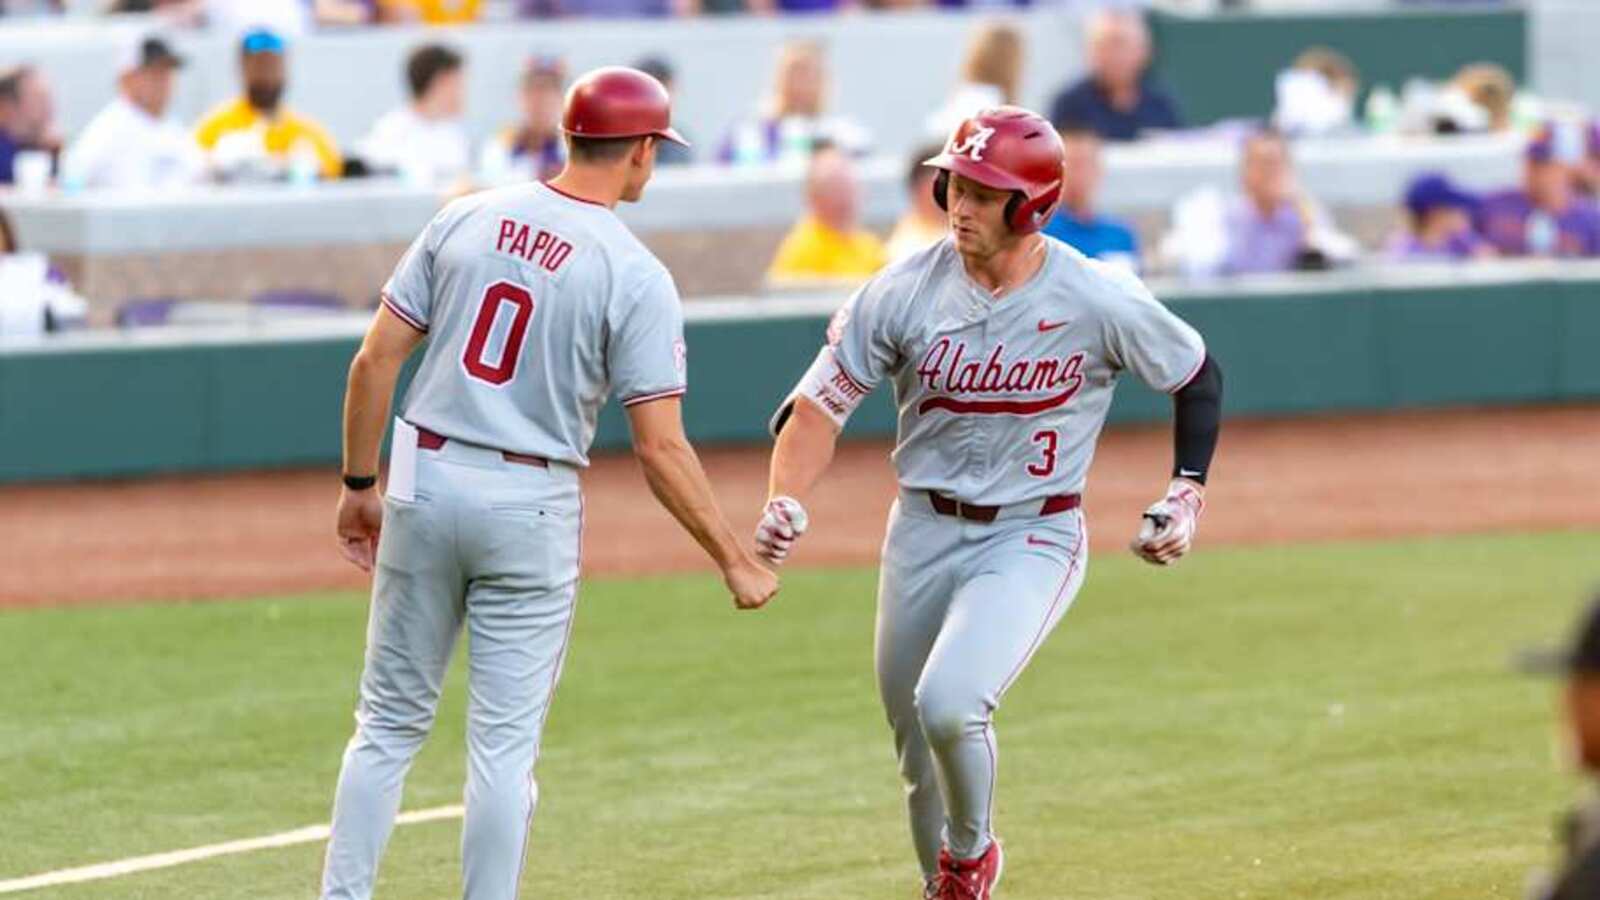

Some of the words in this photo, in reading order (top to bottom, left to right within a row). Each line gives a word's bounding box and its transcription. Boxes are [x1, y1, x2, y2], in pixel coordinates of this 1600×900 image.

[952, 125, 996, 161] A
[496, 217, 574, 275] PAPIO
[461, 279, 536, 388] 0
[916, 337, 1087, 396] Alabama
[1026, 428, 1059, 478] 3
